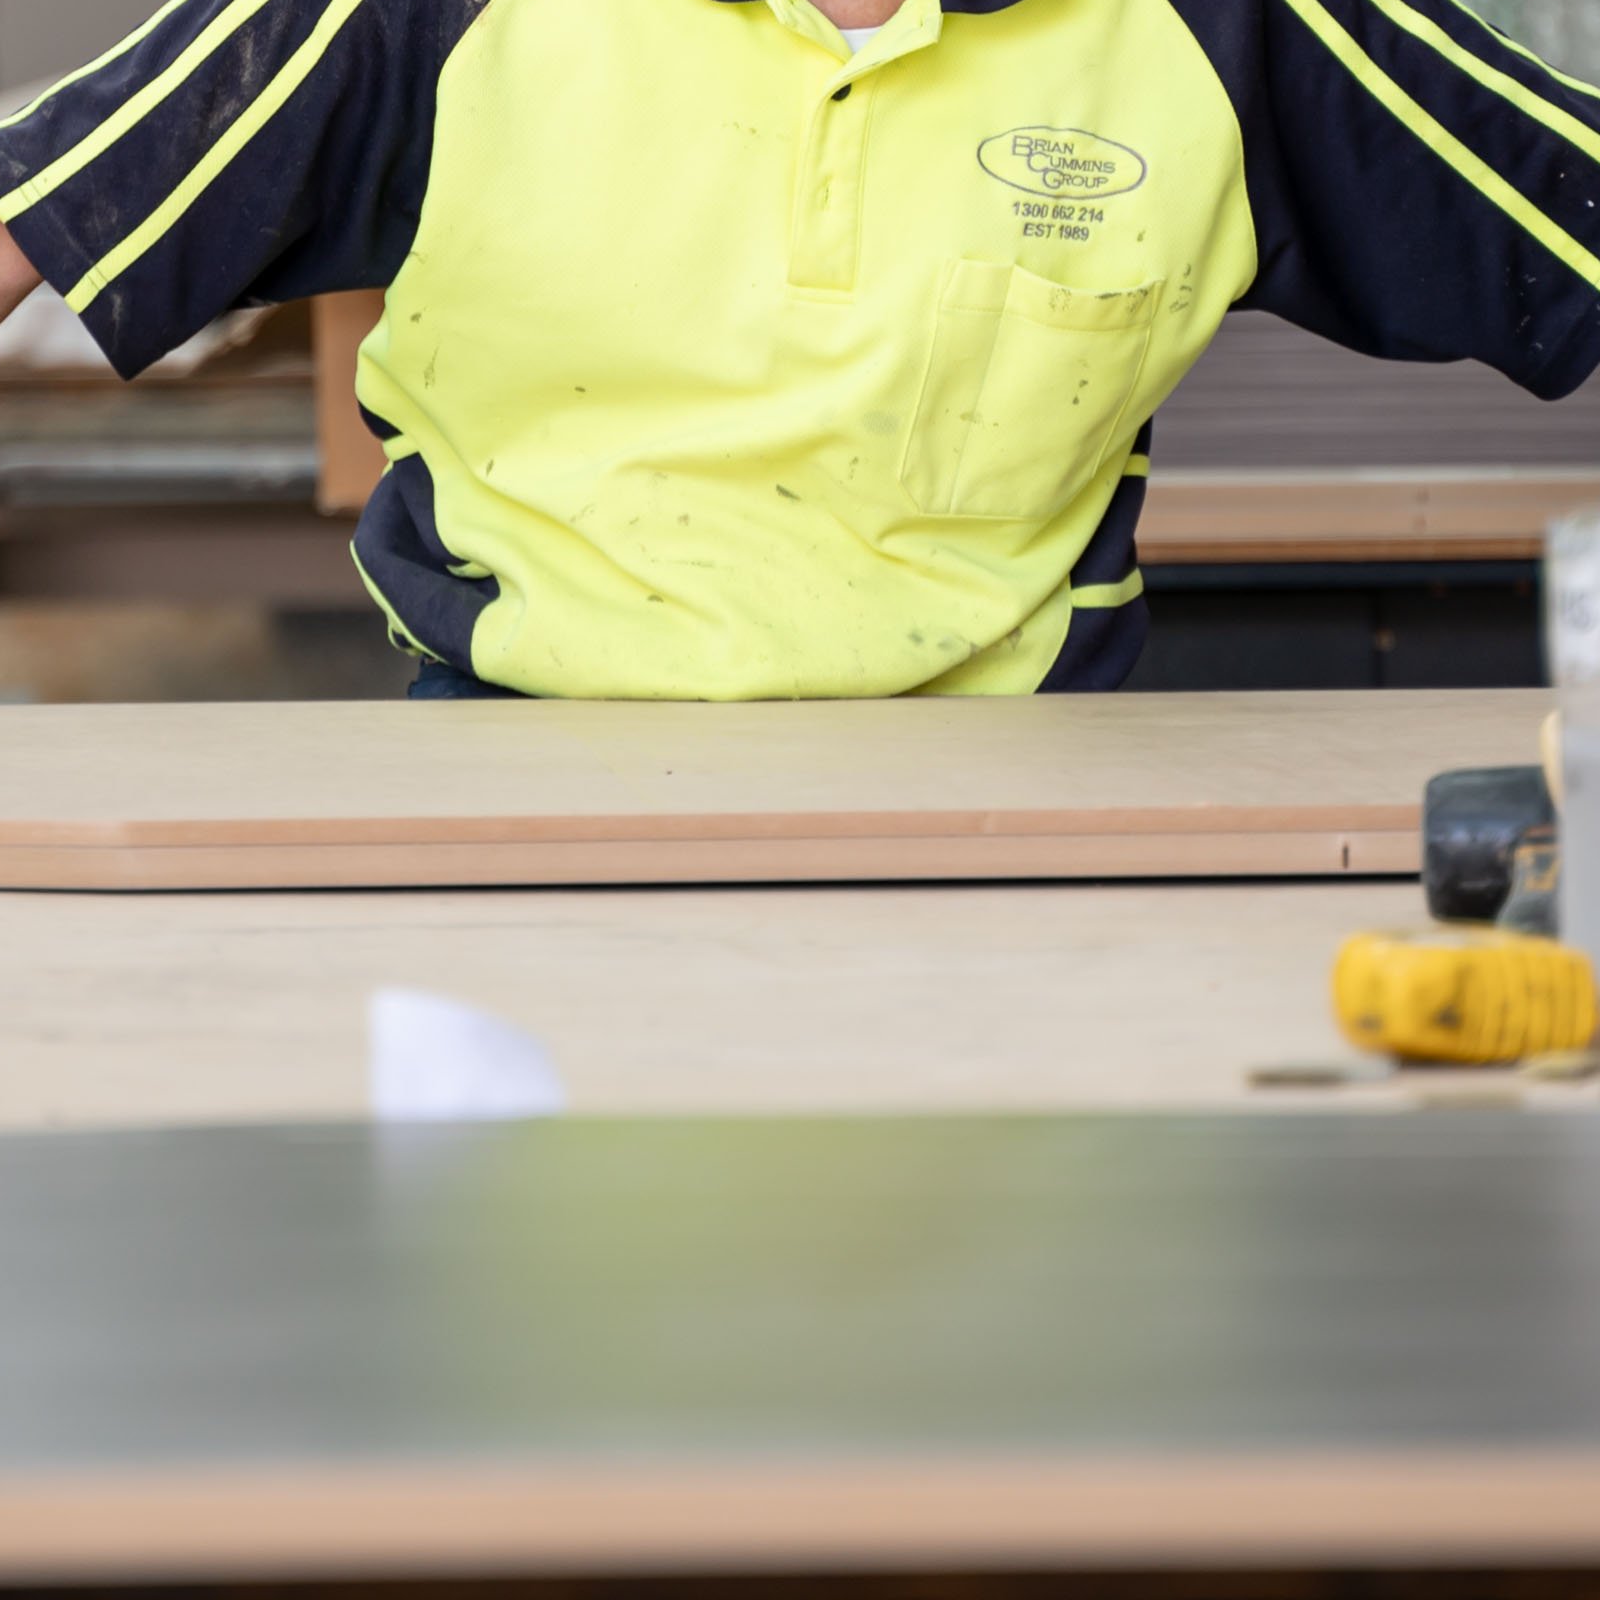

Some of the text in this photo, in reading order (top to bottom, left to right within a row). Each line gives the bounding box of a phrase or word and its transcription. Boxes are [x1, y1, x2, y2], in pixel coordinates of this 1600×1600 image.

[1012, 135, 1075, 156] BRIAN
[1027, 152, 1116, 173] CUMMINS
[1043, 168, 1109, 189] GROUP
[1012, 201, 1104, 223] 1300 662 214
[1023, 223, 1089, 242] EST 1989
